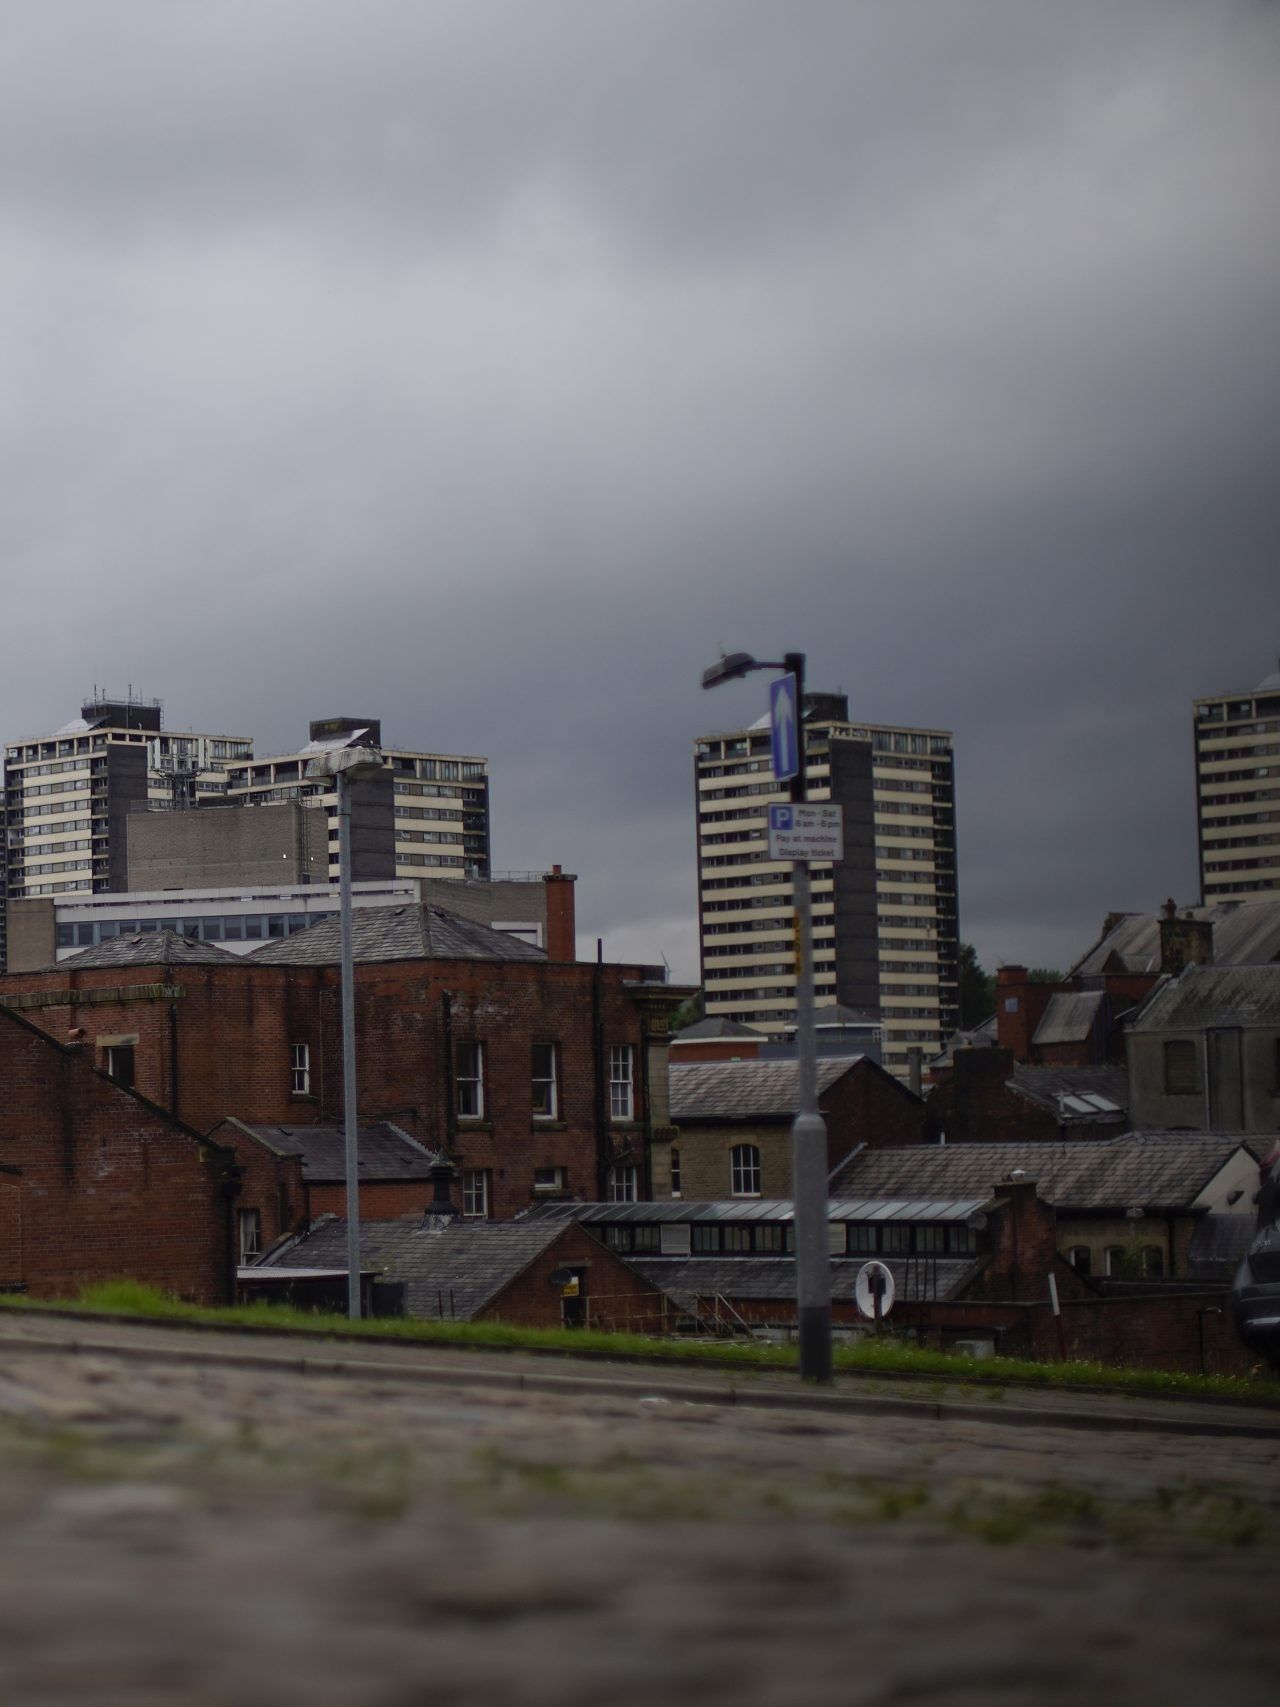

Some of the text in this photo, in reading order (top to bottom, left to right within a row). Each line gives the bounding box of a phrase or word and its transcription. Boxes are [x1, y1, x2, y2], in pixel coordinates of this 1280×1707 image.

[798, 809, 817, 817] Mon
[822, 809, 836, 817] Sat
[775, 809, 790, 828] P
[776, 833, 790, 843] Pay
[803, 835, 837, 843] machine
[780, 848, 835, 857] Display ticket
